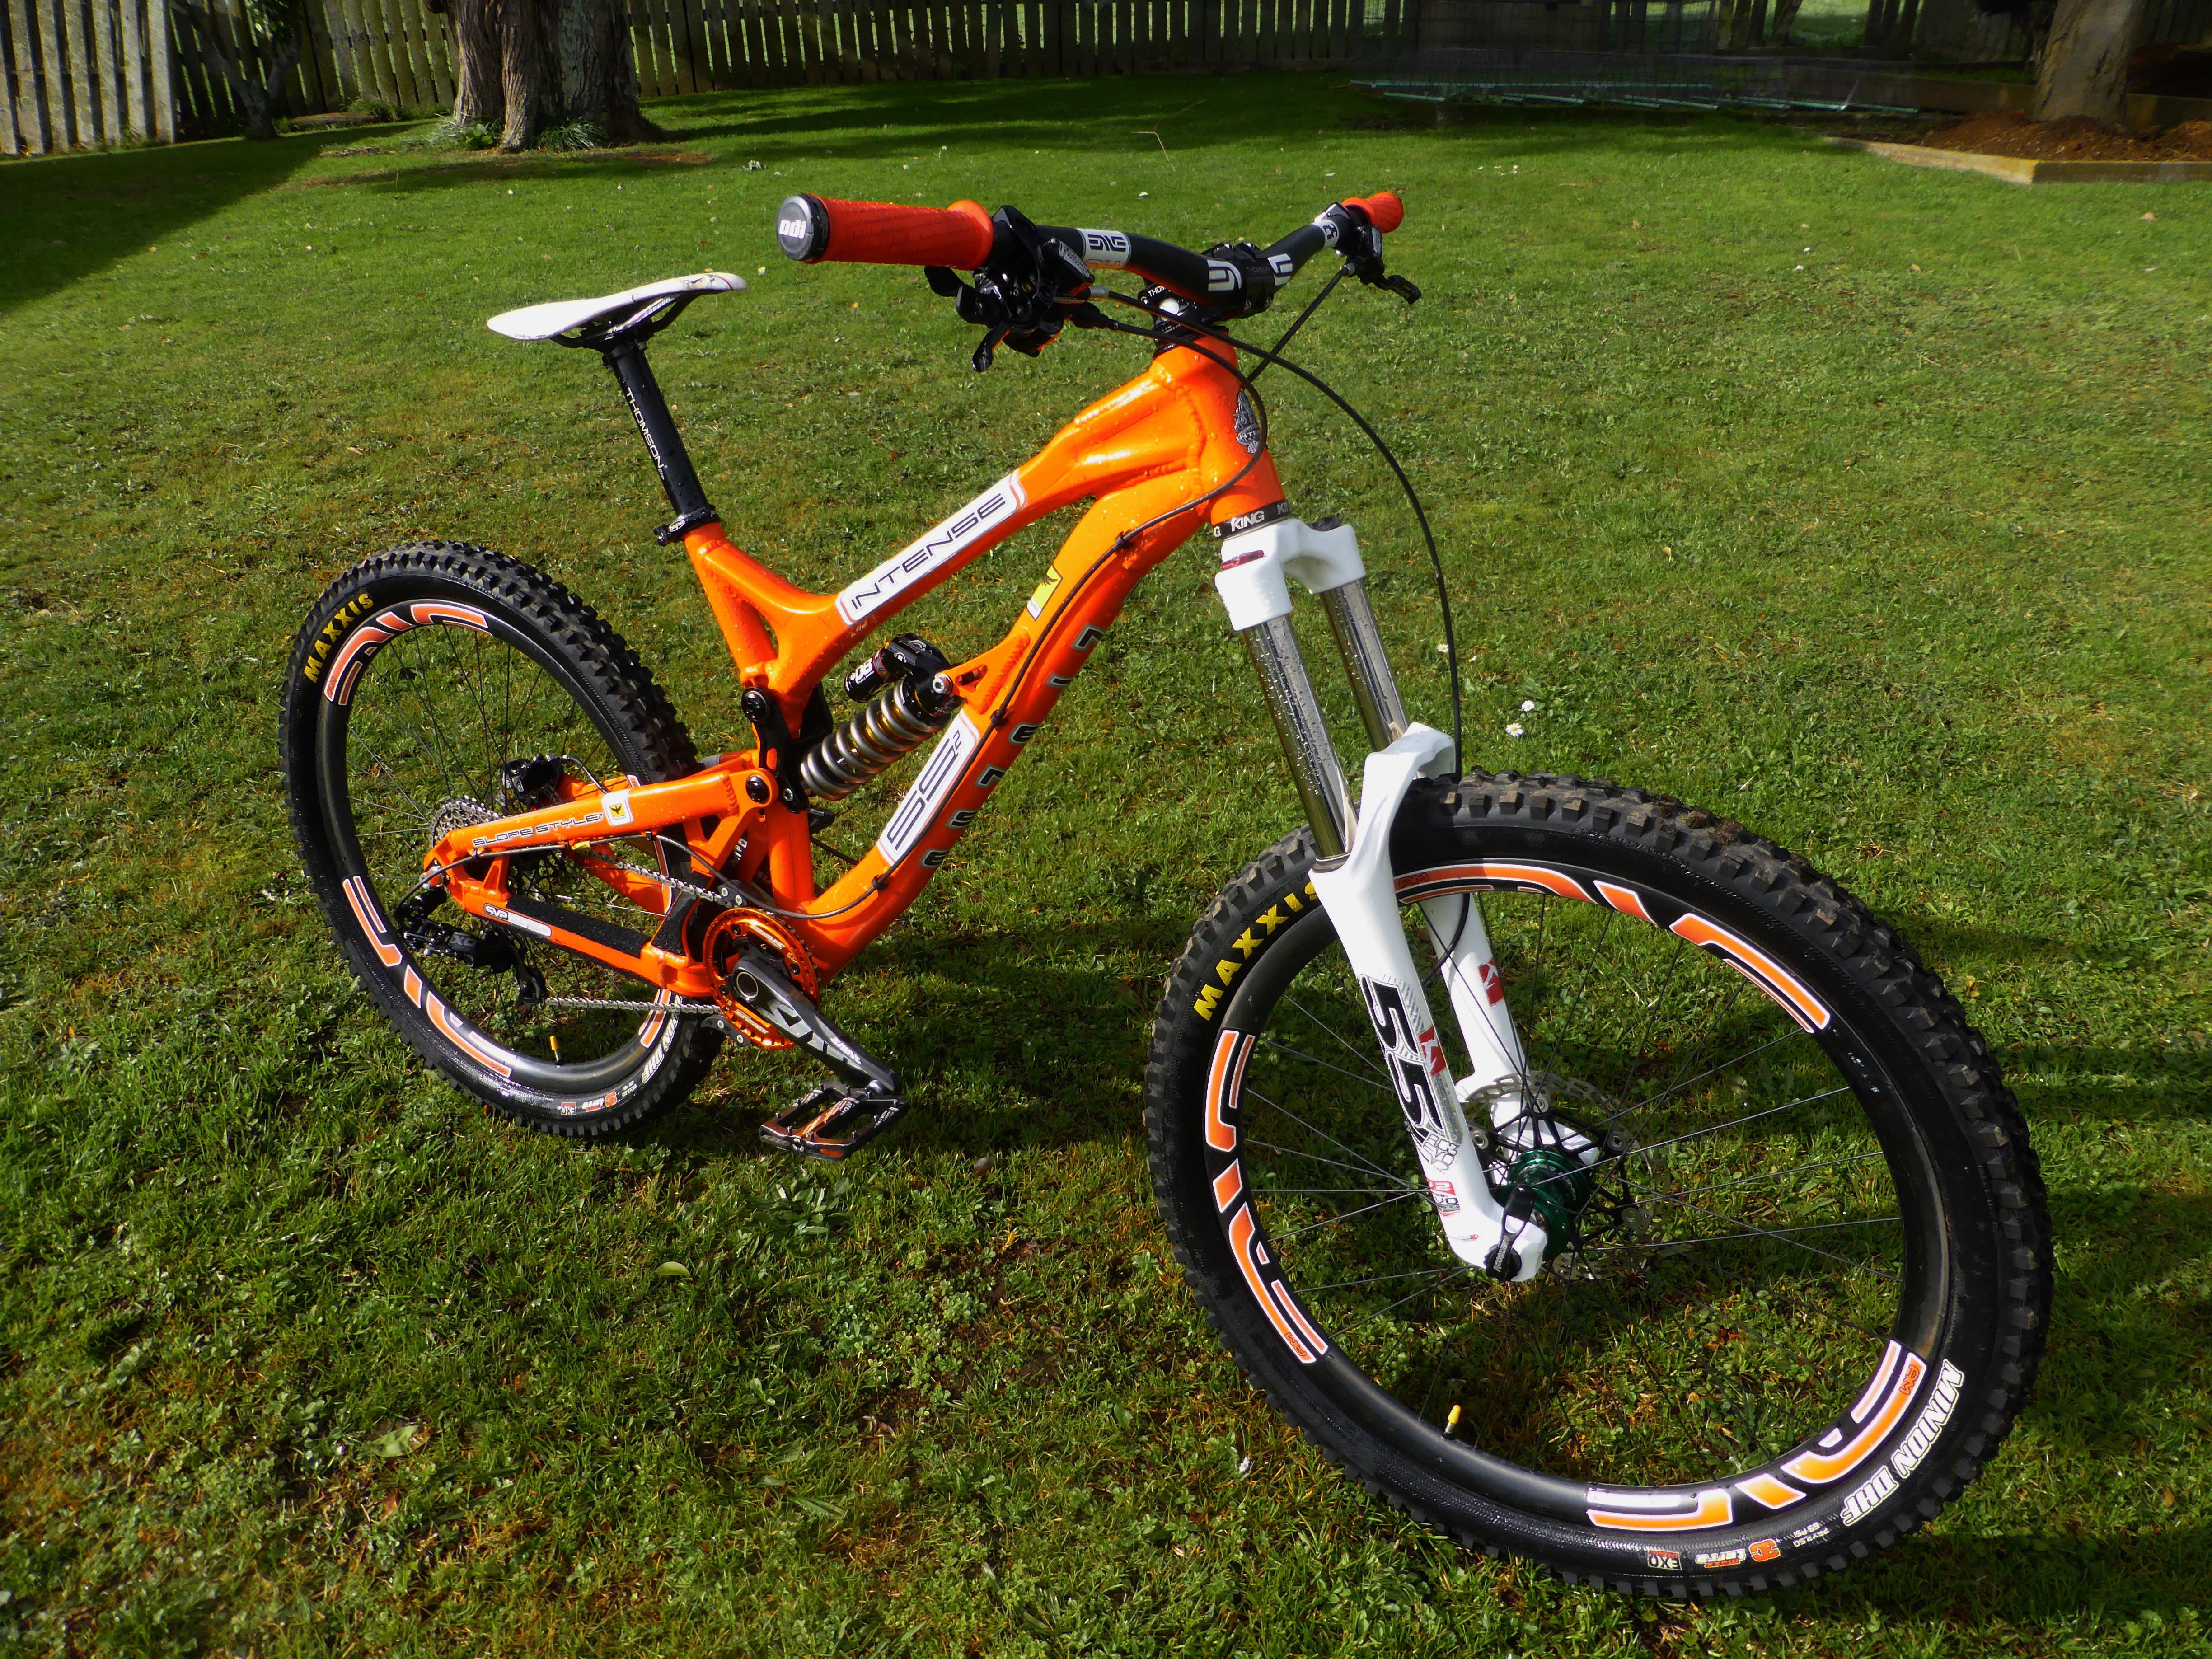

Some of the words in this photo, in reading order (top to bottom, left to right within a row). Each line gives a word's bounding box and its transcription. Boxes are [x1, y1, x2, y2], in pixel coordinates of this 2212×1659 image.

[779, 220, 807, 239] odi
[627, 387, 664, 469] THOMSON
[1231, 510, 1265, 532] KING
[852, 493, 1006, 610] INTENSE
[304, 593, 374, 683] MAXXIS
[473, 828, 533, 847] SLOPE
[642, 1044, 665, 1084] DHF
[1891, 1359, 1964, 1479] MINION
[1839, 1465, 1900, 1526] DHF
[1649, 1554, 1681, 1570] EXO
[1748, 1538, 1781, 1562] 3C
